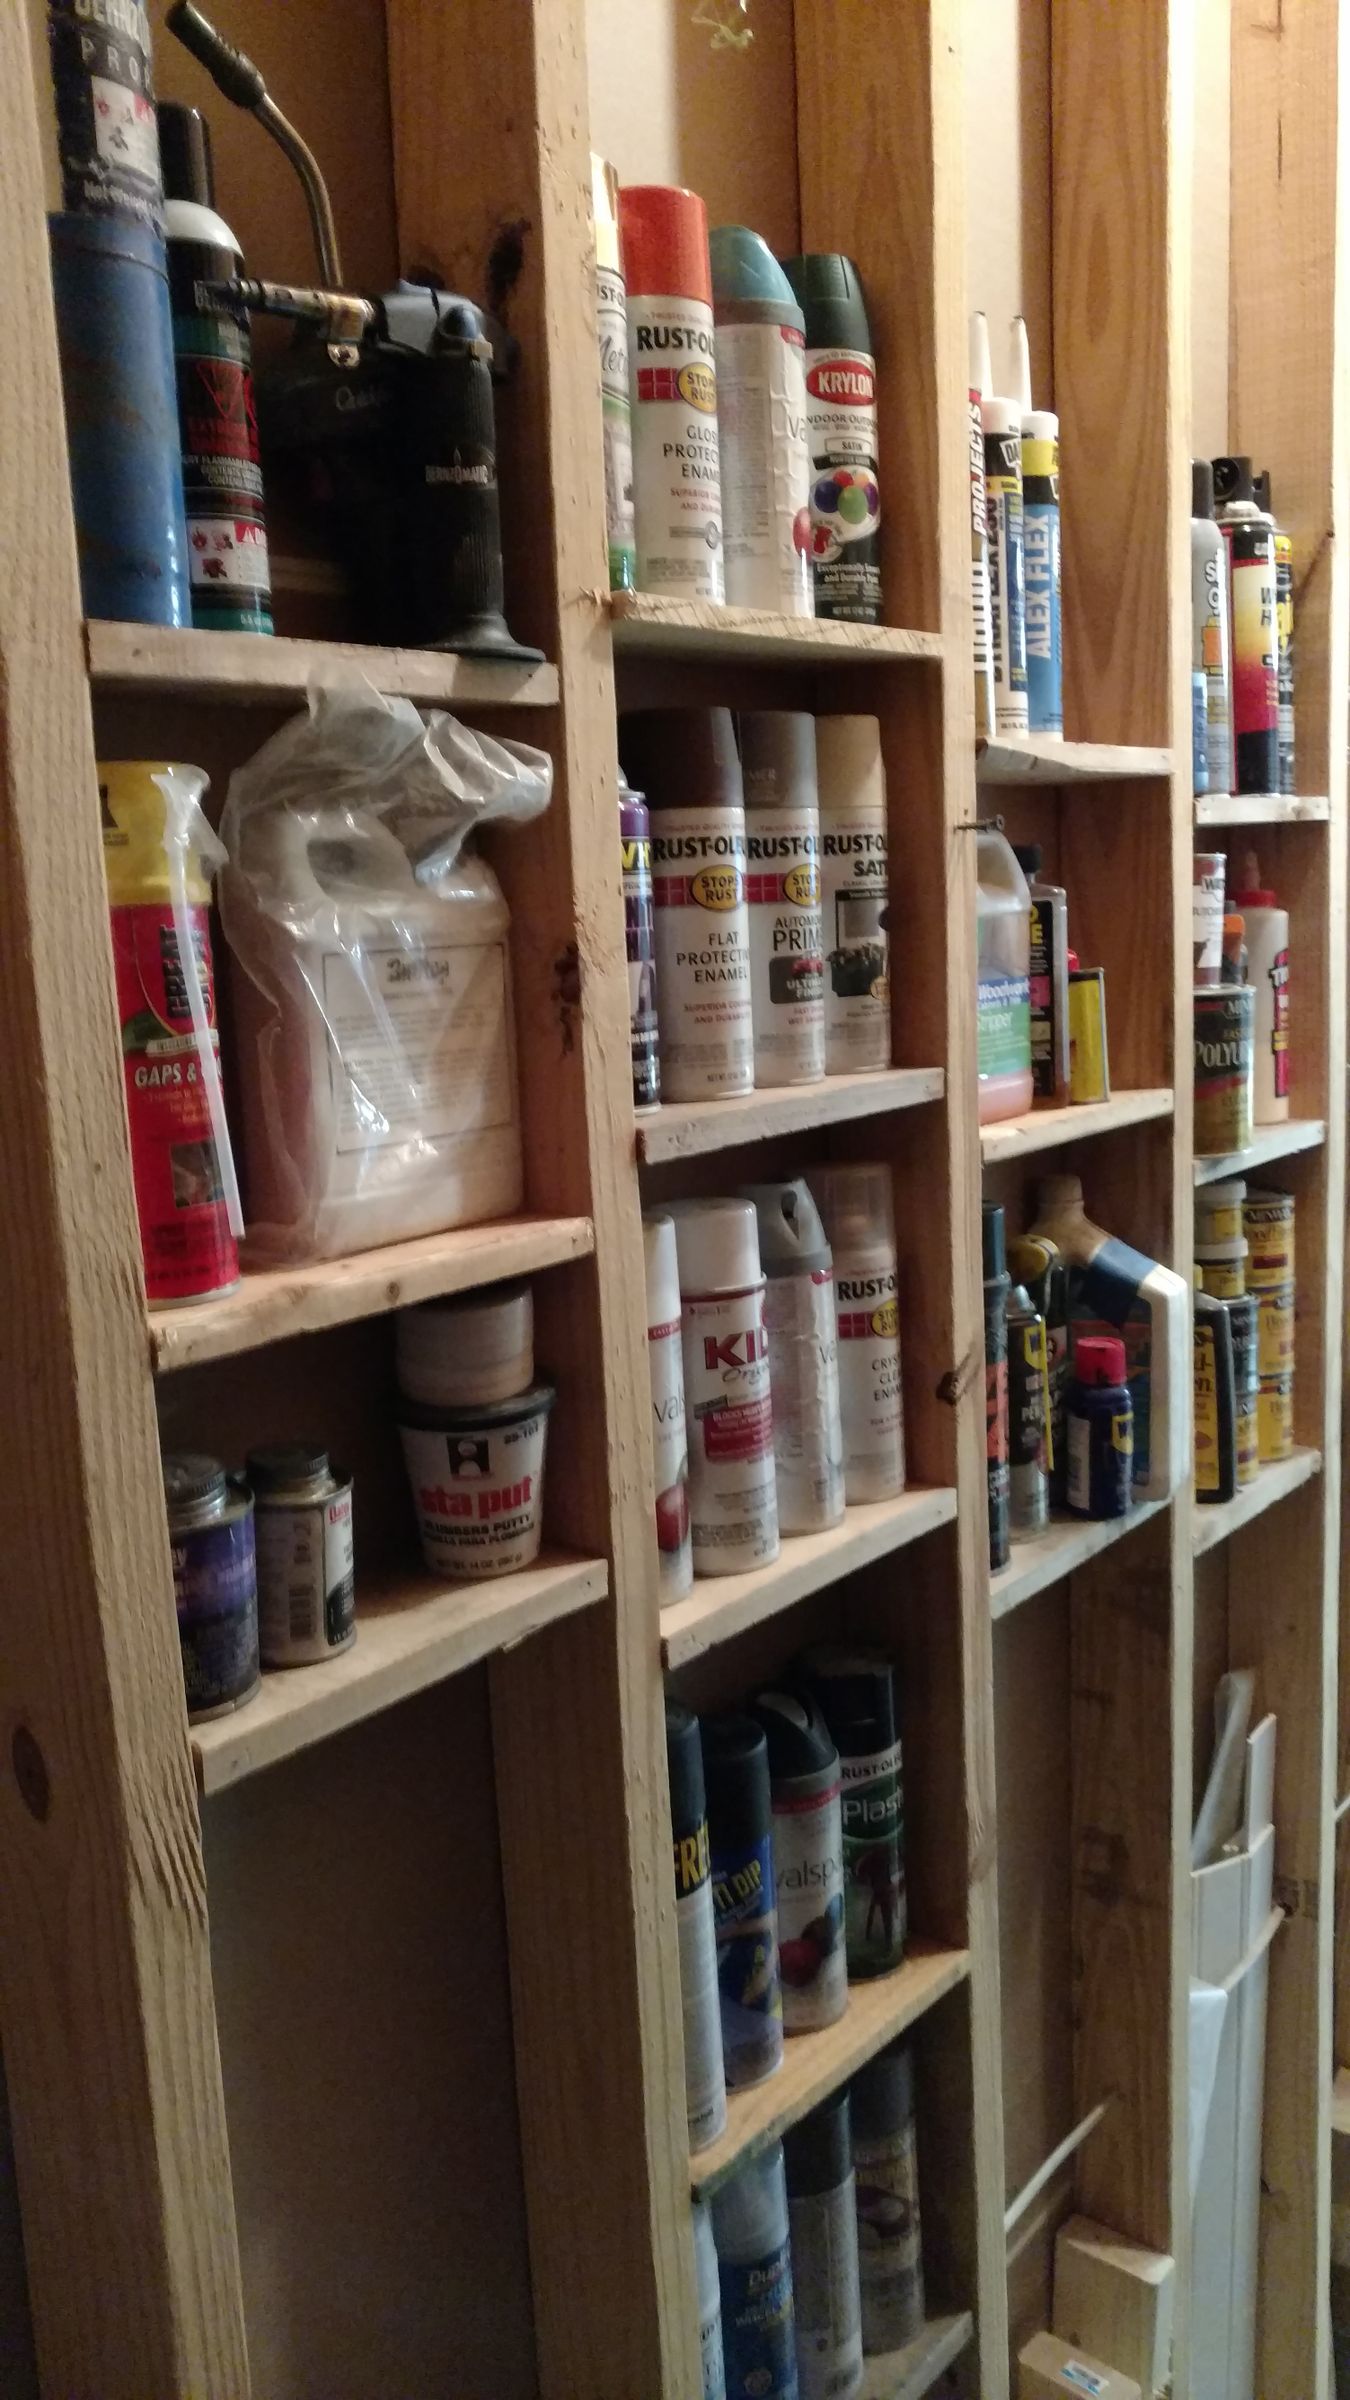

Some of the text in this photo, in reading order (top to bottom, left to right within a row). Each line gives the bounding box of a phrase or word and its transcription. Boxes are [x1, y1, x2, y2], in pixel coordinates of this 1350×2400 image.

[818, 370, 873, 398] KRYLON
[842, 440, 863, 451] SATIN
[970, 403, 987, 536] PROJECTS
[1025, 513, 1051, 660] ALEX FLEX
[708, 932, 739, 947] FLAT
[134, 1062, 182, 1088] GAPS
[420, 1475, 532, 1519] sta put
[493, 1514, 531, 1532] PUTTY
